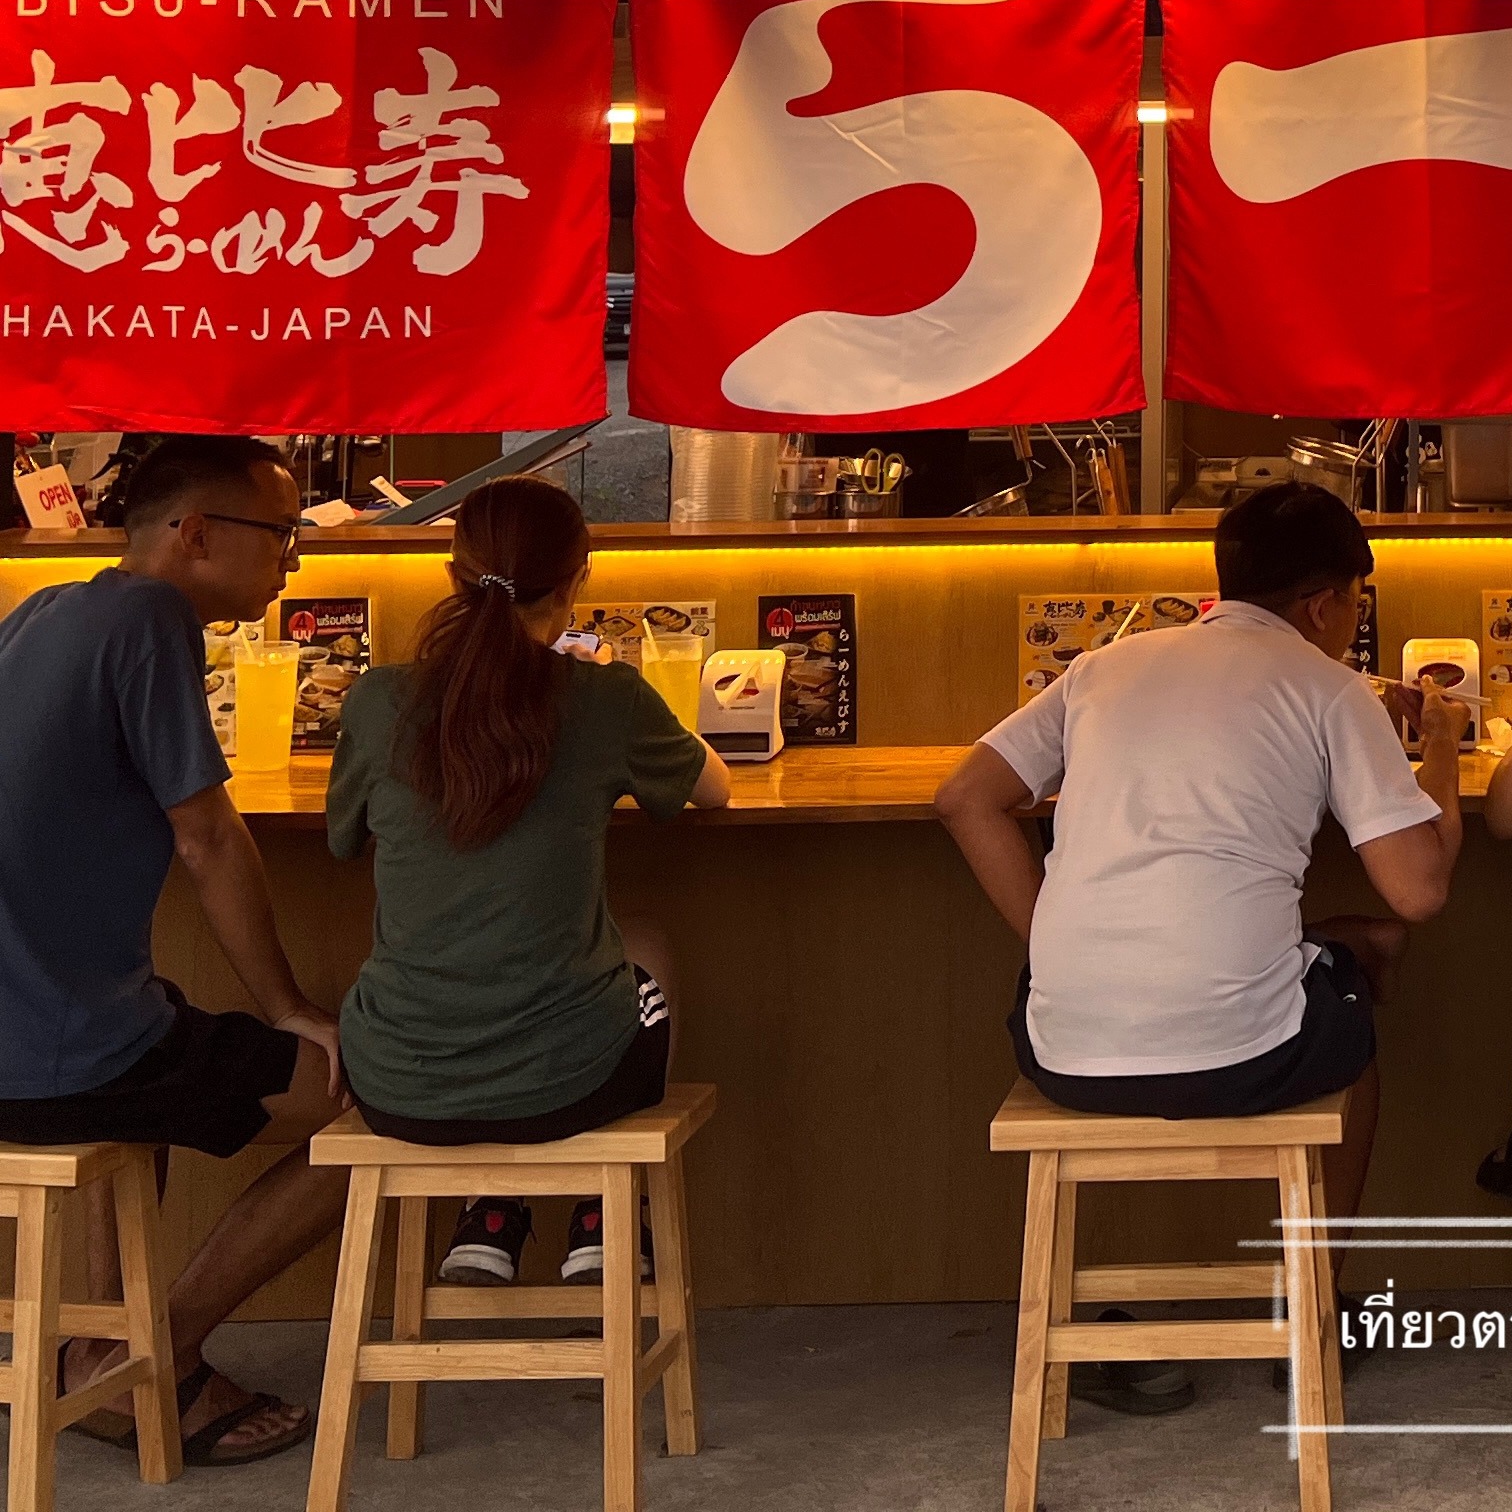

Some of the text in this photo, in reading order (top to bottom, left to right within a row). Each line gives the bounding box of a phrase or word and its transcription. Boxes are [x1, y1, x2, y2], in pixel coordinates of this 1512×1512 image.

[141, 201, 375, 278] らーめん
[3, 304, 433, 341] HAKATA-JAPAN
[38, 481, 74, 511] OPEN
